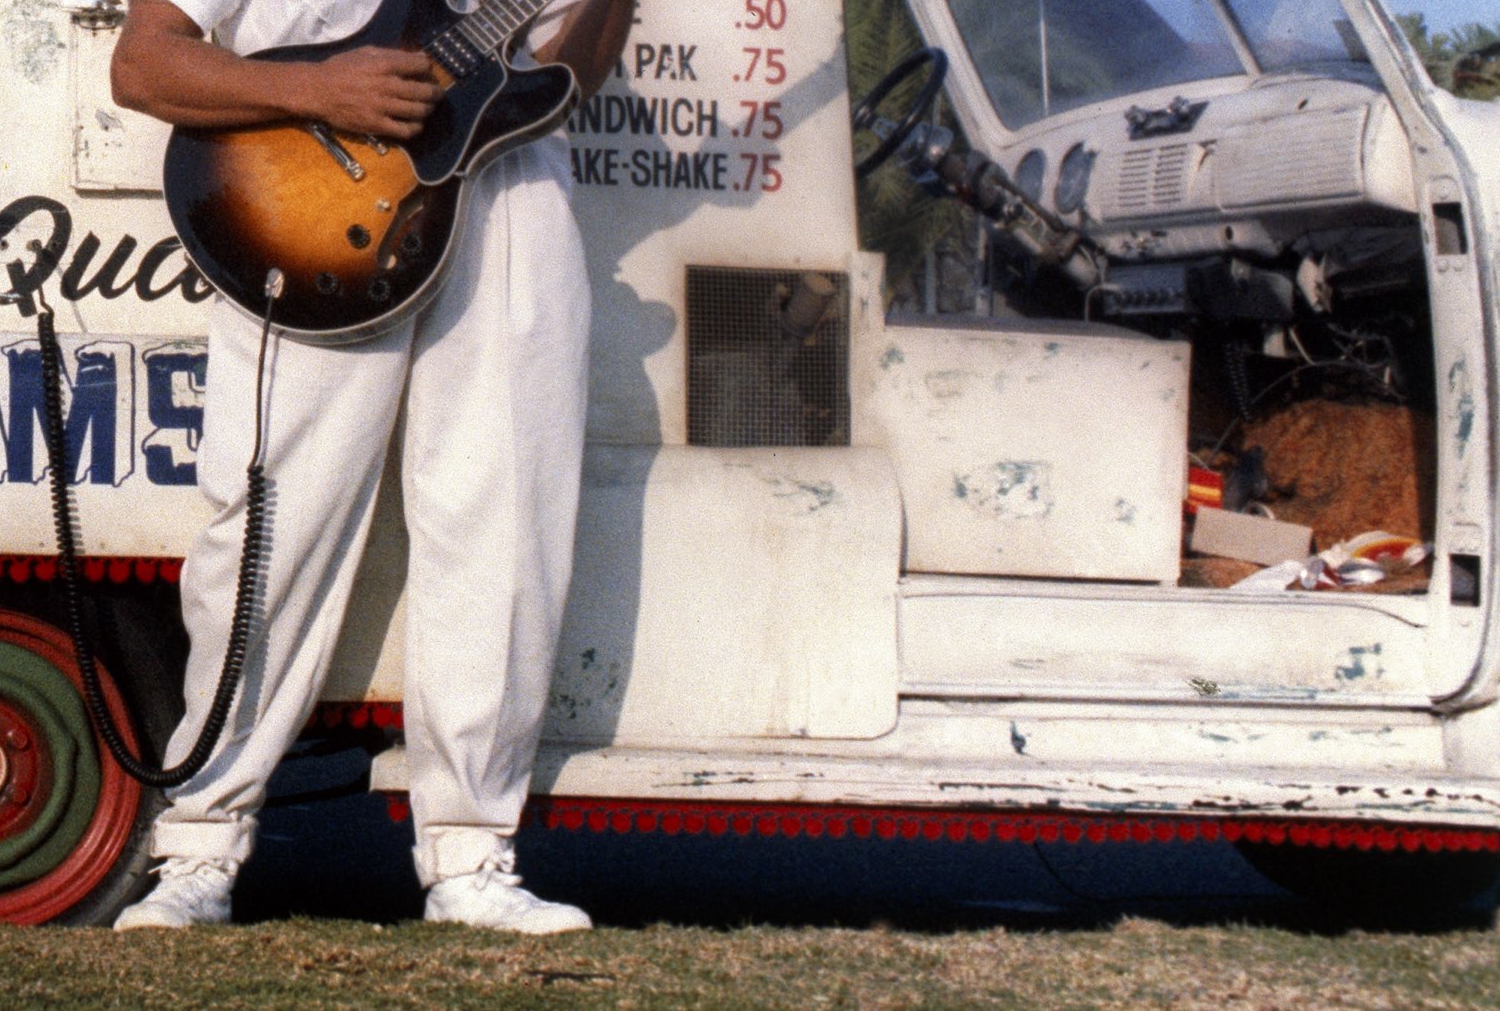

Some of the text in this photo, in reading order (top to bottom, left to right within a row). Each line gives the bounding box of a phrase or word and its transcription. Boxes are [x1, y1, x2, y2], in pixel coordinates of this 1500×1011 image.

[635, 43, 698, 81] PAK
[733, 47, 787, 84] .75
[567, 95, 784, 139] NDWICH .75
[571, 147, 783, 191] AKE-SHAKE .75
